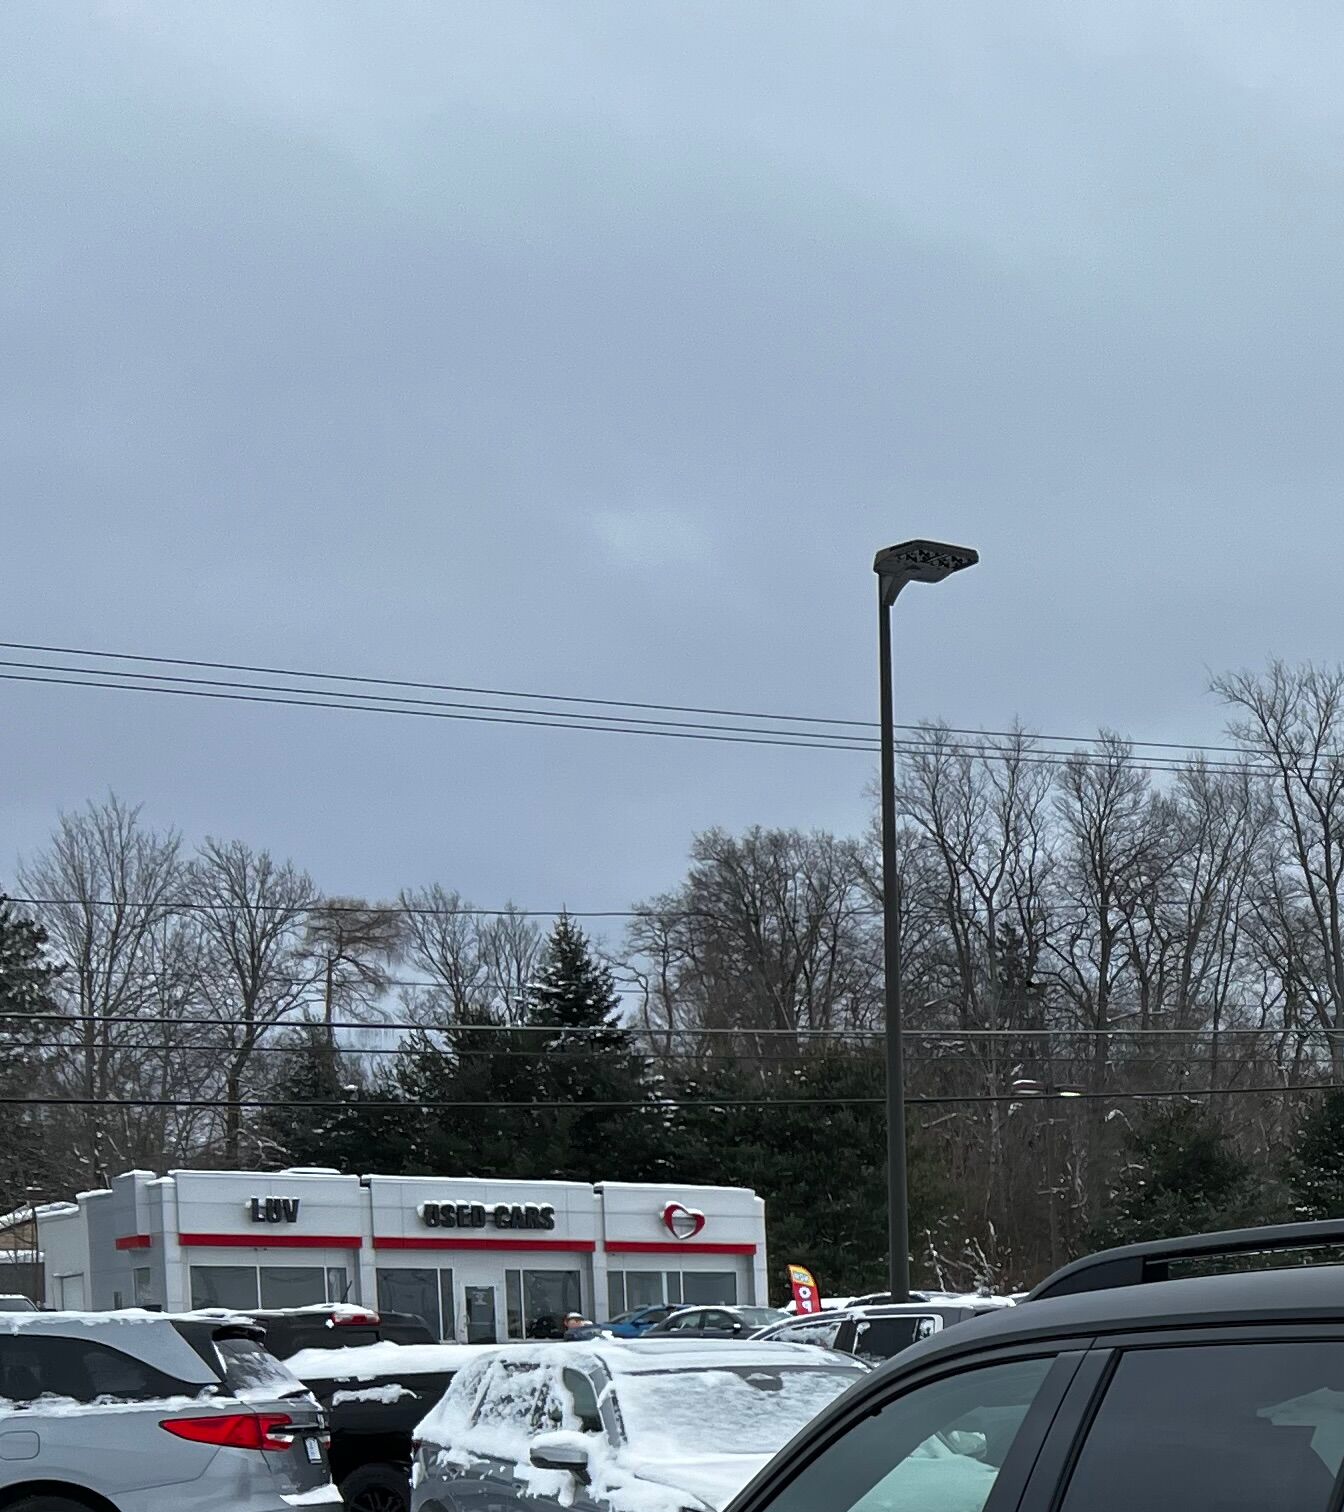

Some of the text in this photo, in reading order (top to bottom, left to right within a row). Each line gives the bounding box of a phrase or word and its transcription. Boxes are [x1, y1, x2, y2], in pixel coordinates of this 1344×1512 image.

[251, 1197, 300, 1223] LUV
[424, 1203, 556, 1230] USED CARS
